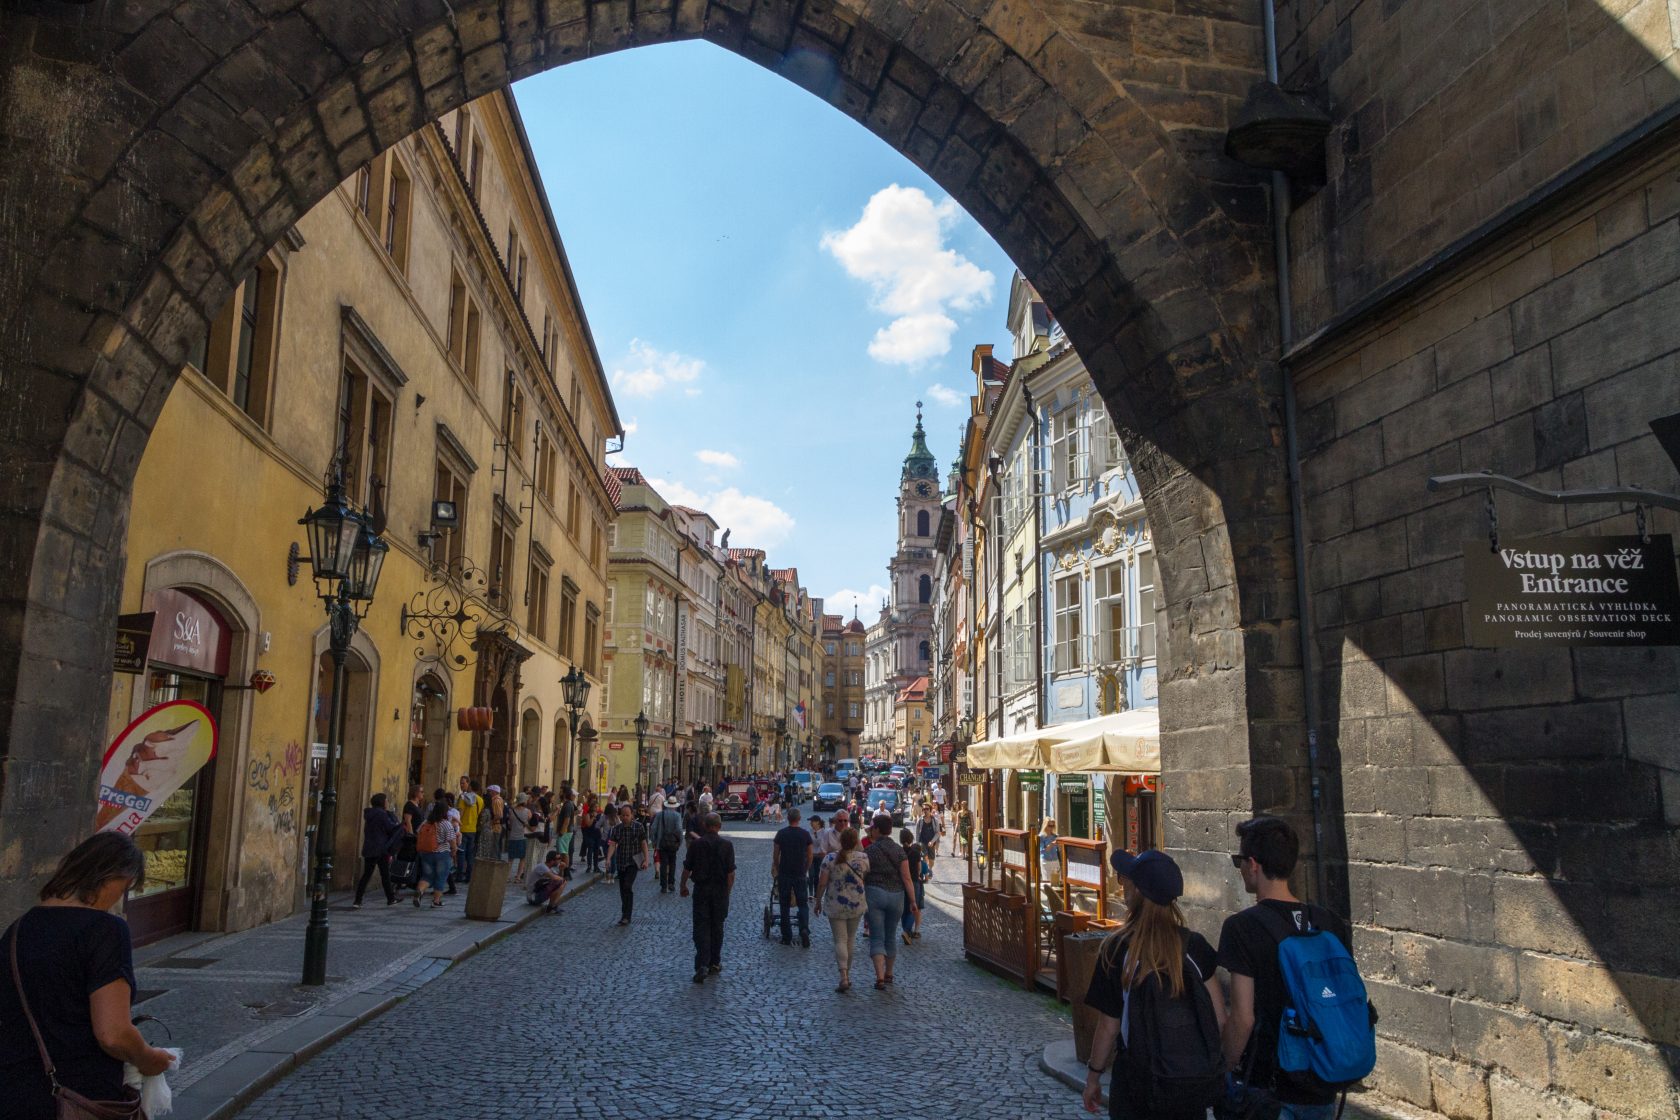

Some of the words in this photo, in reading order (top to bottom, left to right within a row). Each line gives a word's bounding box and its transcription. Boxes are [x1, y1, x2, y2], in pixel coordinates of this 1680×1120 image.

[1500, 549, 1565, 574] Vstup
[1571, 555, 1600, 569] na
[1604, 548, 1644, 569] věž
[1520, 574, 1629, 593] Entrance
[1496, 601, 1594, 611] PANORAMATICKÁ
[1599, 601, 1658, 611] VYHLÍDKA
[174, 611, 200, 644] S&A
[1484, 614, 1553, 623] PANORAMIC
[1558, 614, 1636, 622] OBSERVATION
[1642, 613, 1672, 622] DECK
[1515, 630, 1542, 640] Prodej
[1544, 630, 1581, 639] suvenýrů
[1589, 630, 1624, 638] Souvenir
[1626, 630, 1646, 639] shop
[99, 786, 149, 812] PreGel
